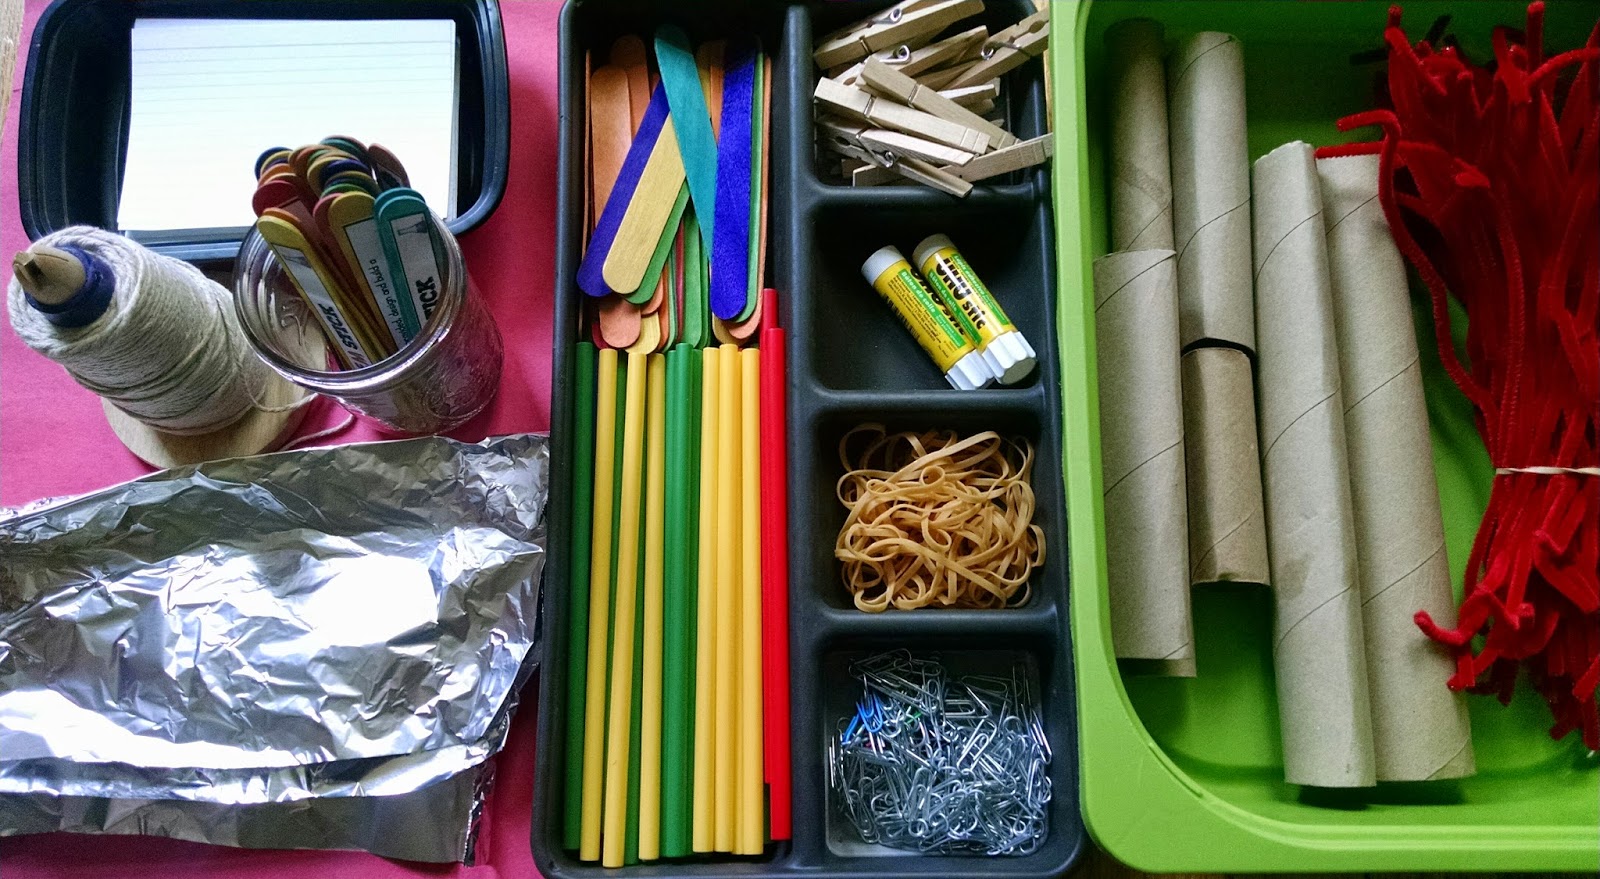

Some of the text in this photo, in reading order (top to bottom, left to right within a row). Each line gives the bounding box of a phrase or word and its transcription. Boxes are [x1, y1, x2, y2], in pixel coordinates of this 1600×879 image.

[368, 265, 385, 284] build
[376, 282, 390, 295] and
[936, 258, 972, 300] UHU
[962, 301, 986, 330] stic
[386, 296, 400, 317] design
[318, 303, 358, 350] STICK
